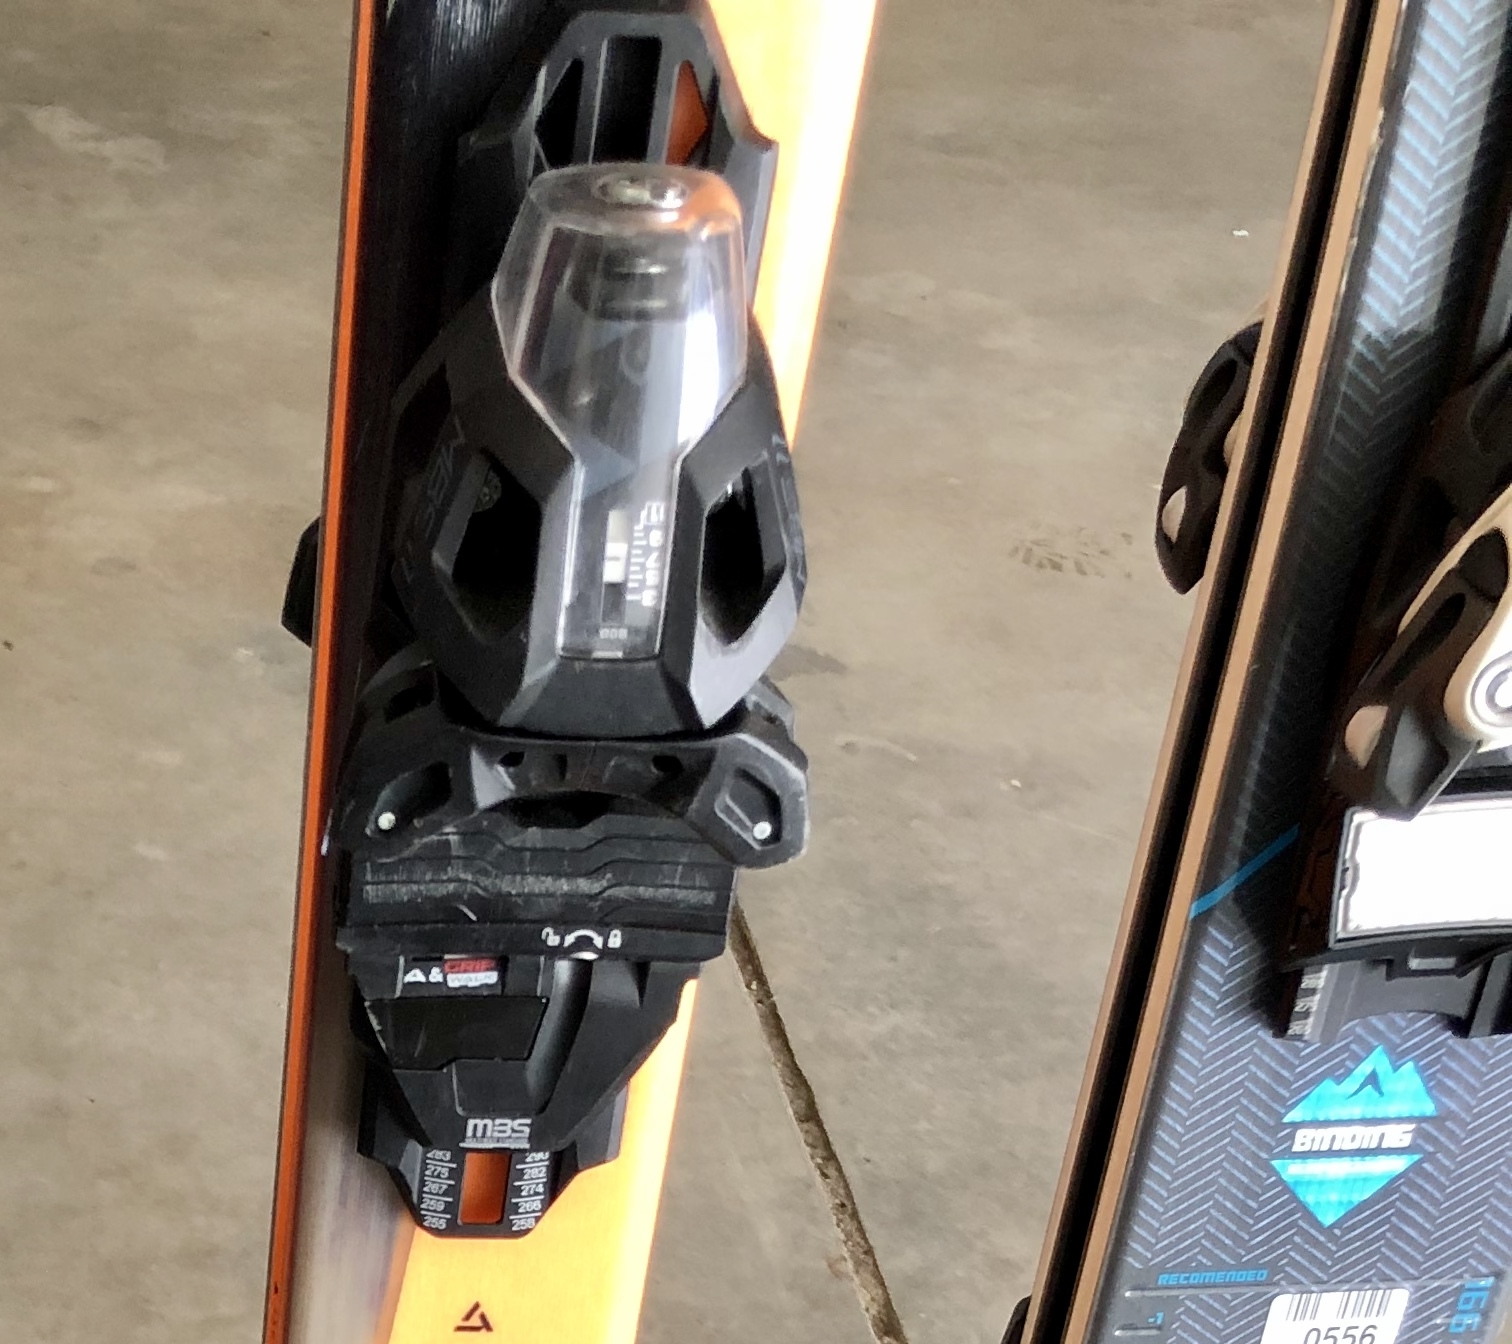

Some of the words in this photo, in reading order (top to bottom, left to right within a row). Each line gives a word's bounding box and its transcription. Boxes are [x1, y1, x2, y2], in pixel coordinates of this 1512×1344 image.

[1291, 1123, 1417, 1152] BINDING
[424, 1166, 450, 1178] 275
[422, 1182, 449, 1195] 267
[521, 1185, 545, 1196] 274
[420, 1199, 446, 1211] 259
[422, 1216, 447, 1230] 255
